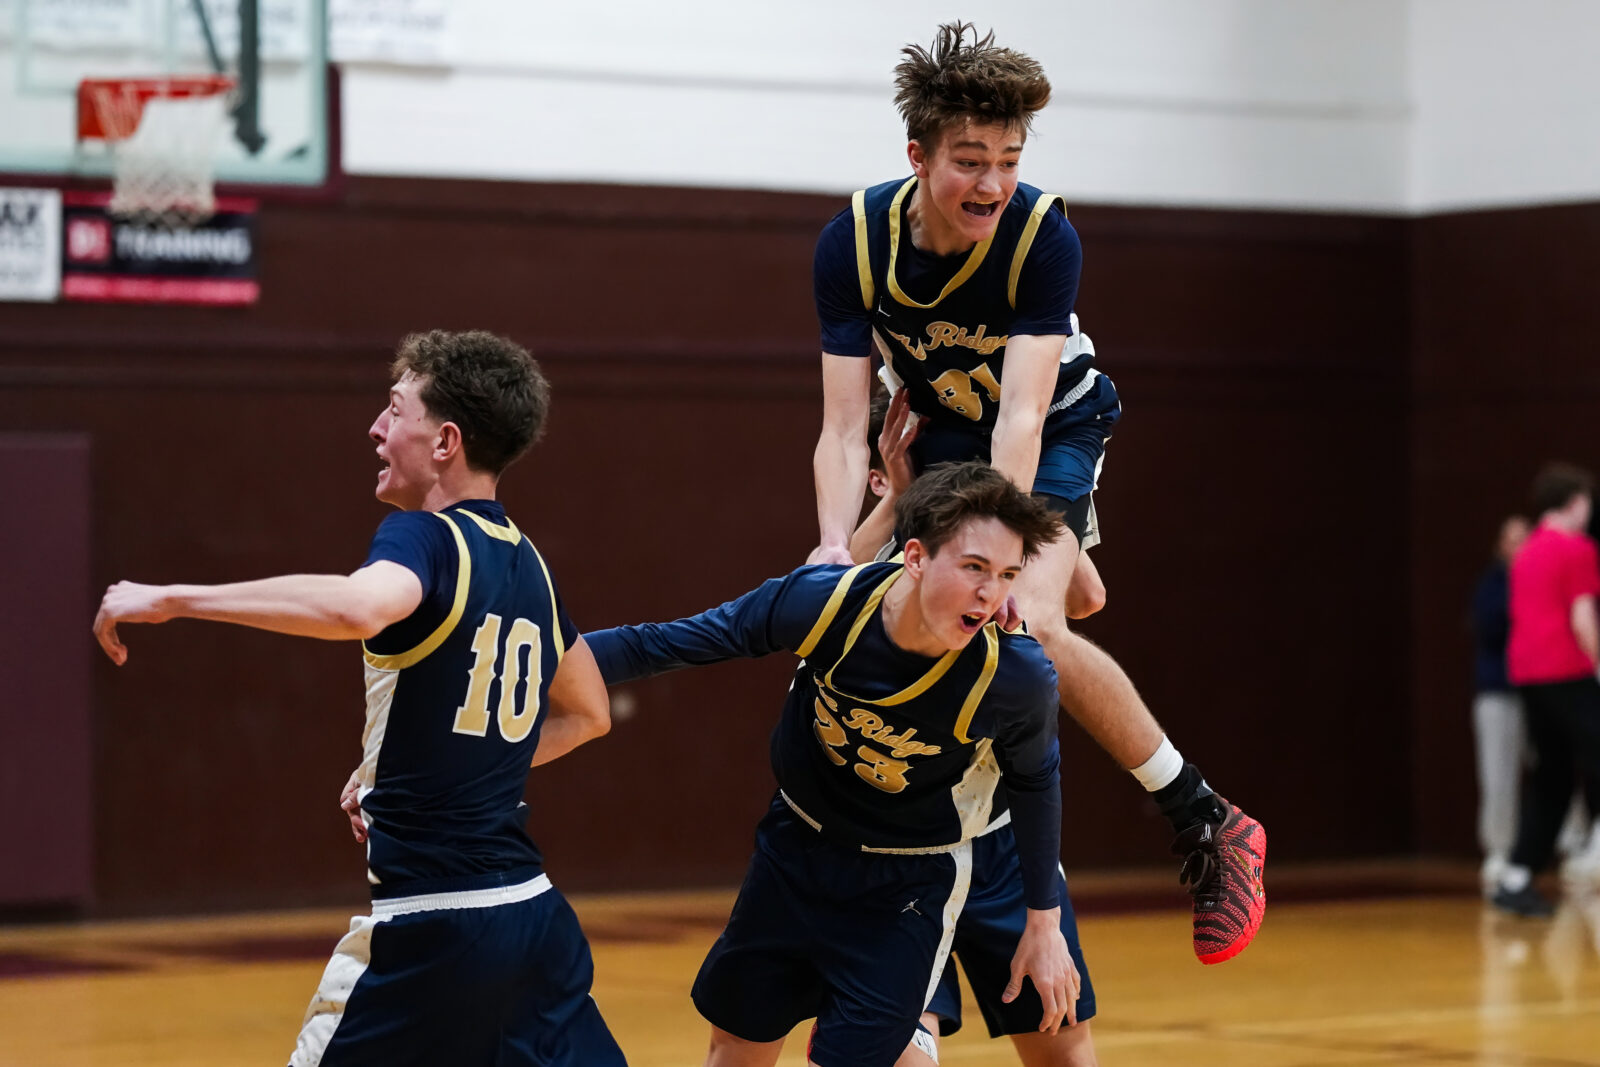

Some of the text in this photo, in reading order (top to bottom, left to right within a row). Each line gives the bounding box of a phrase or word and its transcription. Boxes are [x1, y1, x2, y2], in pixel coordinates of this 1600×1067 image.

[452, 613, 543, 743] 10
[813, 697, 914, 794] 23
[842, 708, 942, 758] Ridge
